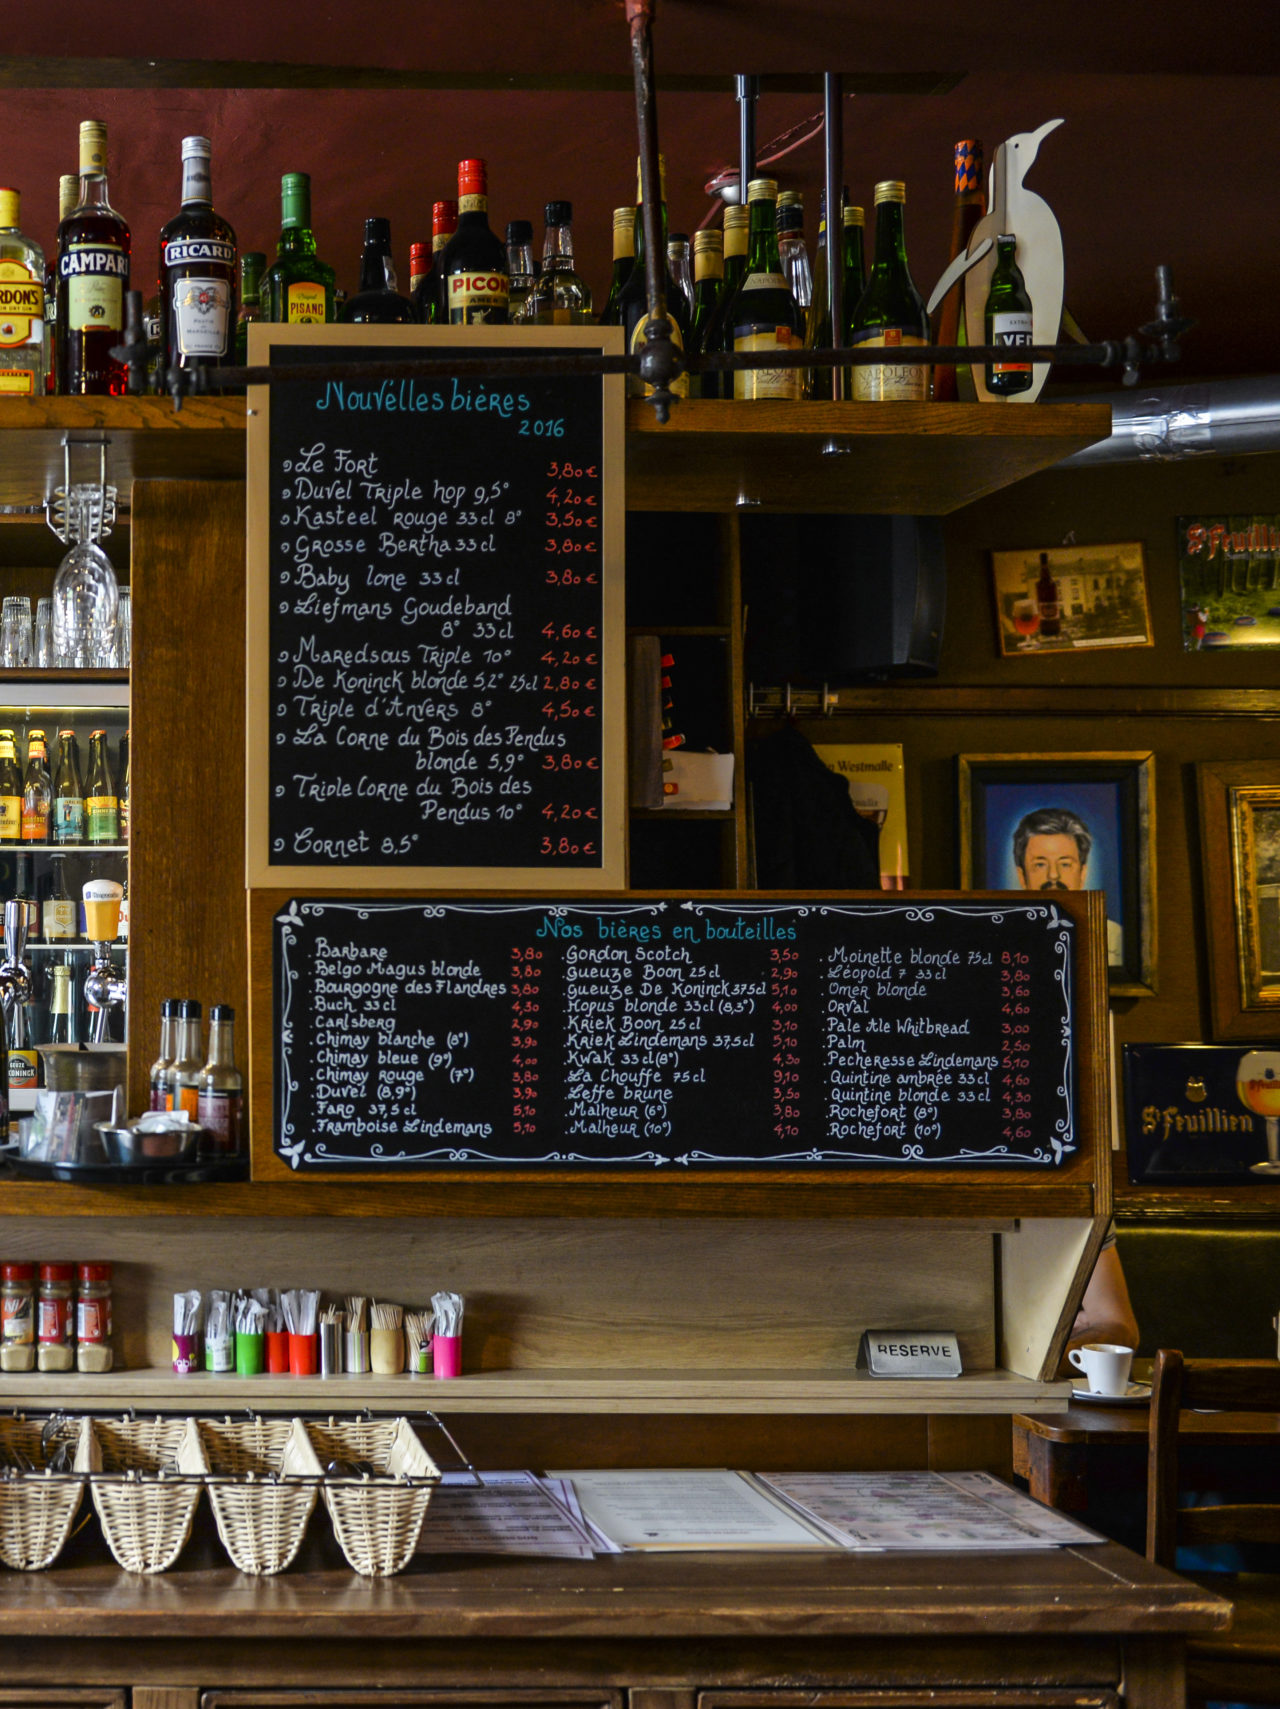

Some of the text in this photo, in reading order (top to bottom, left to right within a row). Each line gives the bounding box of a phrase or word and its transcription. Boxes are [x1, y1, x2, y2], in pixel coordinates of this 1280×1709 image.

[169, 245, 233, 259] RICARD
[60, 251, 129, 276] CAMPARI
[452, 275, 509, 294] PICON
[290, 302, 324, 316] PISANG
[519, 419, 564, 436] 2016
[295, 443, 325, 472] Le
[295, 477, 351, 500] Duvel
[360, 479, 422, 509] Triple
[434, 480, 465, 508] hop
[294, 505, 376, 529] Kasteel
[294, 535, 365, 562] Grosse
[379, 532, 451, 557] Bertha
[294, 563, 349, 595] Baby
[294, 593, 511, 626] Liefmans Goudeband
[293, 635, 410, 668] Maredsous
[418, 645, 471, 677] Triple
[293, 664, 324, 688] De
[333, 670, 404, 694] Koninck
[411, 670, 468, 696] blonde
[293, 695, 354, 726] Triple
[293, 723, 566, 751] La Corne du Bois des Pendus
[416, 749, 477, 774] blonde
[838, 760, 893, 772] Westmalle
[357, 776, 408, 802] Corne
[416, 777, 441, 795] du
[452, 777, 493, 798] Bois
[500, 775, 531, 794] des
[420, 799, 490, 825] Pendus
[294, 827, 369, 858] Cornet
[536, 913, 582, 937] Nos
[673, 927, 700, 943] en
[706, 917, 796, 939] bouteilles
[512, 948, 542, 962] 3,80
[635, 945, 692, 964] Scotch
[771, 948, 798, 963] 3,50
[315, 960, 541, 980] Belgo Magus blonde 3,80
[315, 978, 539, 1002] Bourgogne des Flandres 3,80
[877, 981, 926, 1000] blonde
[1002, 986, 1029, 996] 3,60
[1002, 1003, 1029, 1015] 4,60
[512, 1019, 538, 1031] 2,90
[827, 1017, 860, 1032] Pale
[866, 1018, 890, 1033] Ale
[1002, 1024, 1029, 1033] 3,00
[827, 1034, 1030, 1052] Palm 2,50
[918, 1052, 998, 1070] Lindemans
[1003, 1056, 1029, 1068] 5,10
[568, 1084, 615, 1105] Leffe
[774, 1087, 799, 1102] 3,50
[775, 1104, 800, 1119] 3,80
[316, 1117, 536, 1138] Framboise Lindemans 5,10
[877, 1344, 952, 1358] RESERVE
